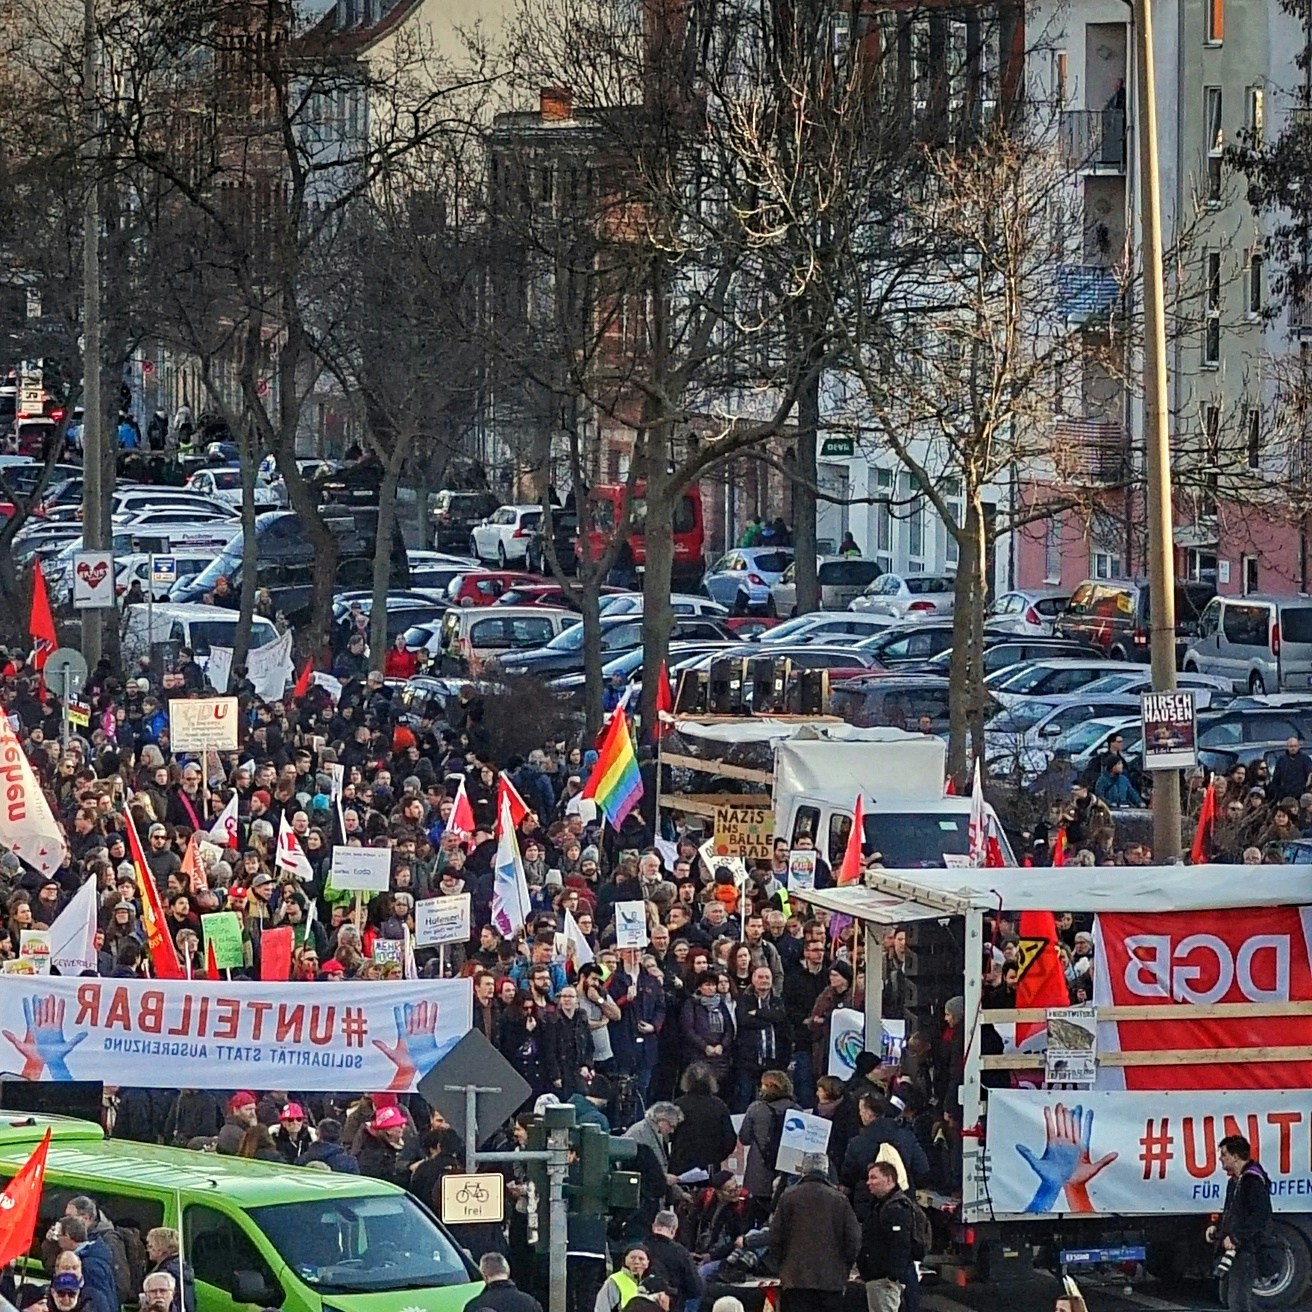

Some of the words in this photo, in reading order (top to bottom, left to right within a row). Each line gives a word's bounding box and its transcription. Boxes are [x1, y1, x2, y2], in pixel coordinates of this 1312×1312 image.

[1143, 694, 1192, 709] HIRSCH
[1144, 708, 1193, 723] HAUSEN
[1139, 1112, 1312, 1180] #UNT
[1193, 1181, 1220, 1199] FÜR
[464, 1205, 482, 1216] frei
